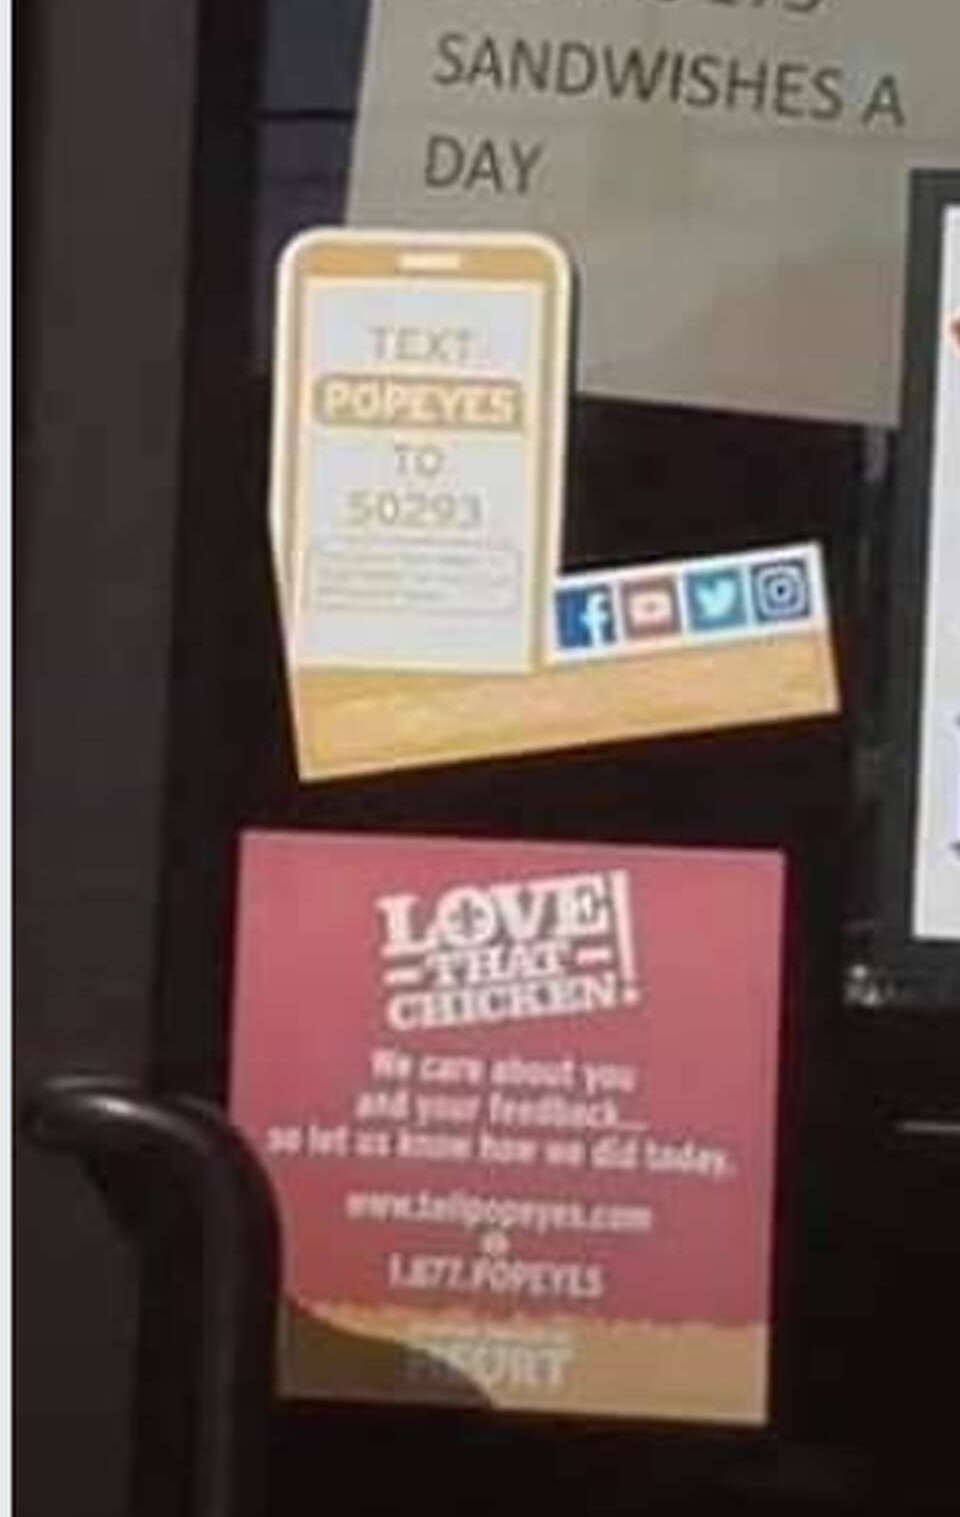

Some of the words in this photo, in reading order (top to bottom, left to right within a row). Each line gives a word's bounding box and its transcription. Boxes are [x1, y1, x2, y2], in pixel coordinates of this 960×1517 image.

[434, 32, 842, 120] SANDWISHES
[862, 76, 906, 127] A
[424, 135, 544, 194] DAY
[368, 325, 474, 363] TEXT
[324, 385, 515, 423] POPEYES
[393, 444, 444, 478] TO
[347, 491, 482, 530] 50293
[376, 873, 610, 957] LOVE
[371, 1047, 411, 1079] We
[420, 1053, 482, 1084] care
[492, 1056, 576, 1087] about
[583, 1062, 637, 1096] you
[355, 1090, 406, 1122] and
[417, 1095, 482, 1128] your
[267, 1126, 300, 1153] so
[307, 1125, 349, 1156] let
[396, 1130, 476, 1161] know
[479, 1133, 539, 1165] how
[591, 1135, 639, 1170] did
